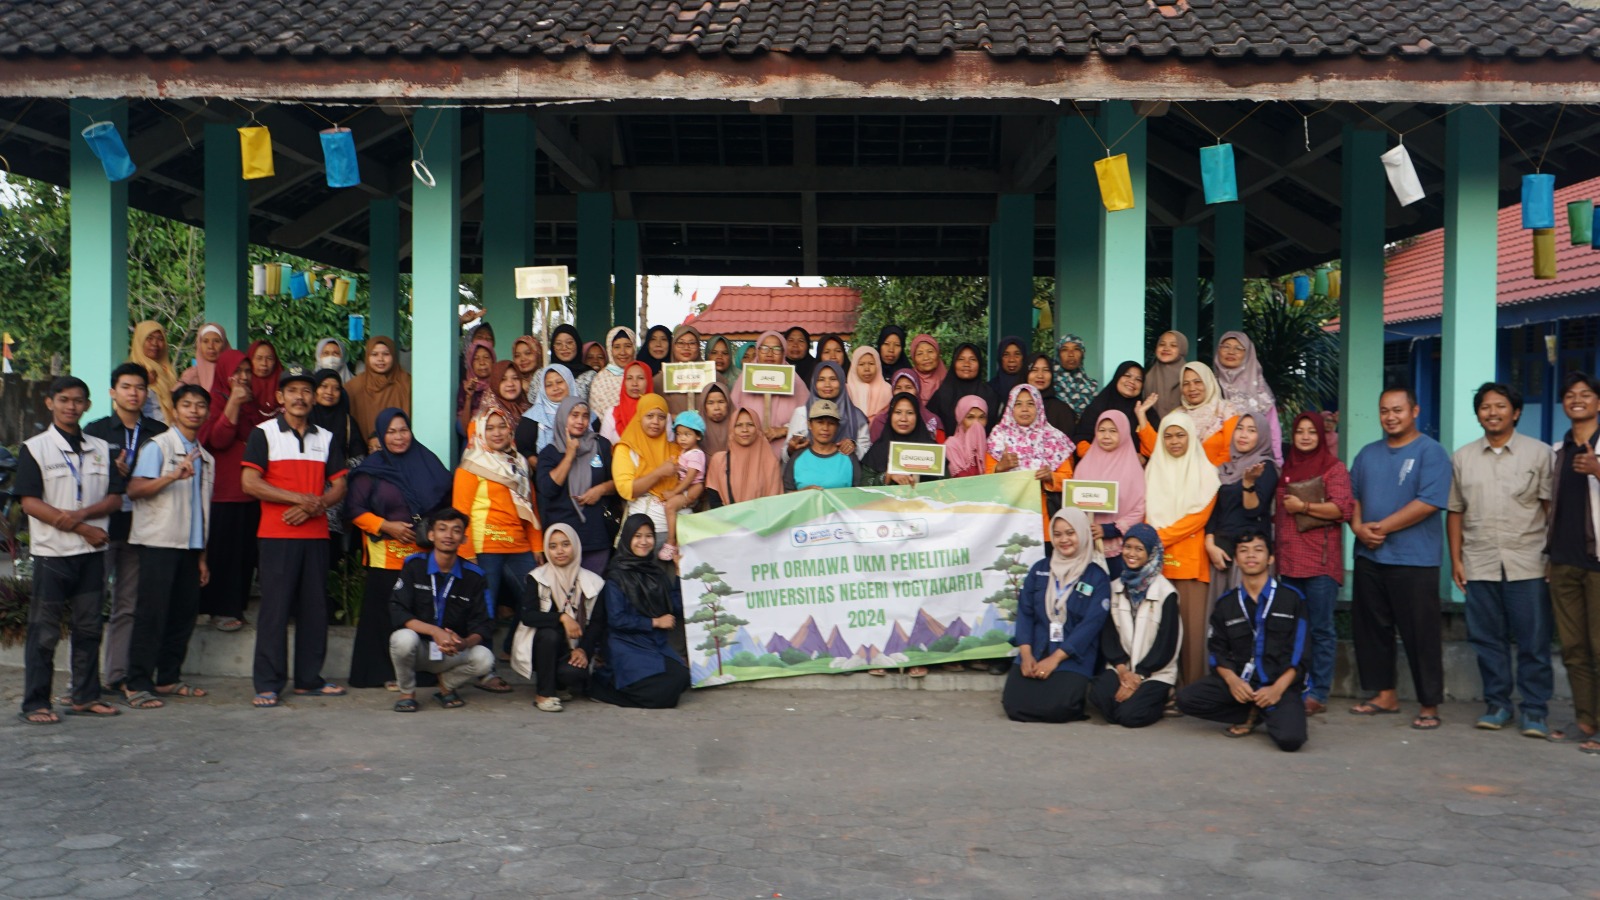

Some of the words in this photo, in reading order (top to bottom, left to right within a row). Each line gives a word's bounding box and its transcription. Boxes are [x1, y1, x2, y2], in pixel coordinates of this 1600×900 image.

[751, 562, 779, 581] PPK
[784, 556, 849, 578] ORMAWA
[854, 555, 886, 572] UKM
[890, 547, 970, 571] PENELITIAN
[746, 585, 834, 609] UNIVERSITAS
[839, 582, 888, 601] NEGERI
[892, 571, 983, 598] YOGYAKARTA
[848, 609, 886, 628] 2024
